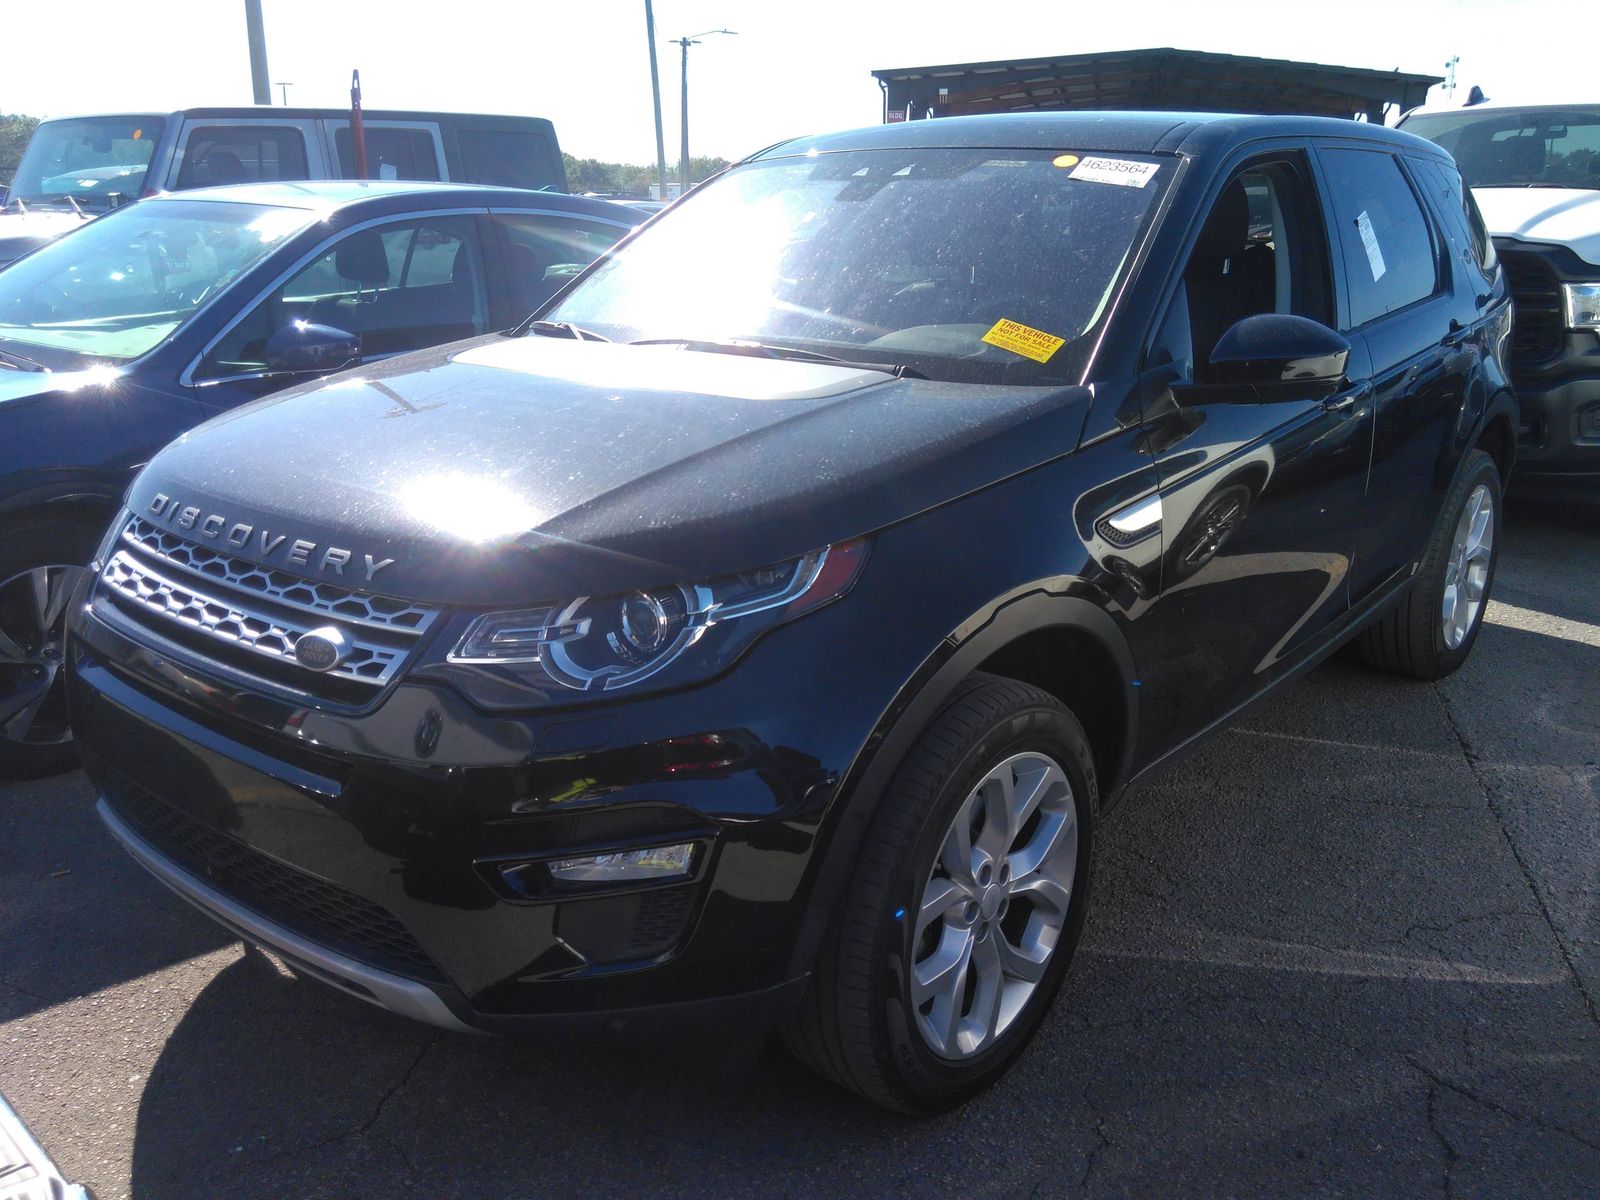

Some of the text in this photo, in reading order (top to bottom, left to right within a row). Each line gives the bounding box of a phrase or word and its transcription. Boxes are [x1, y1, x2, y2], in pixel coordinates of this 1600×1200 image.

[1082, 159, 1150, 175] 4623564
[997, 327, 1013, 337] NOT
[1014, 333, 1031, 342] FOR
[1032, 339, 1053, 350] SALE
[1001, 320, 1022, 332] THIS
[1023, 328, 1060, 346] VEHICLE
[150, 492, 395, 582] DISCOVERY
